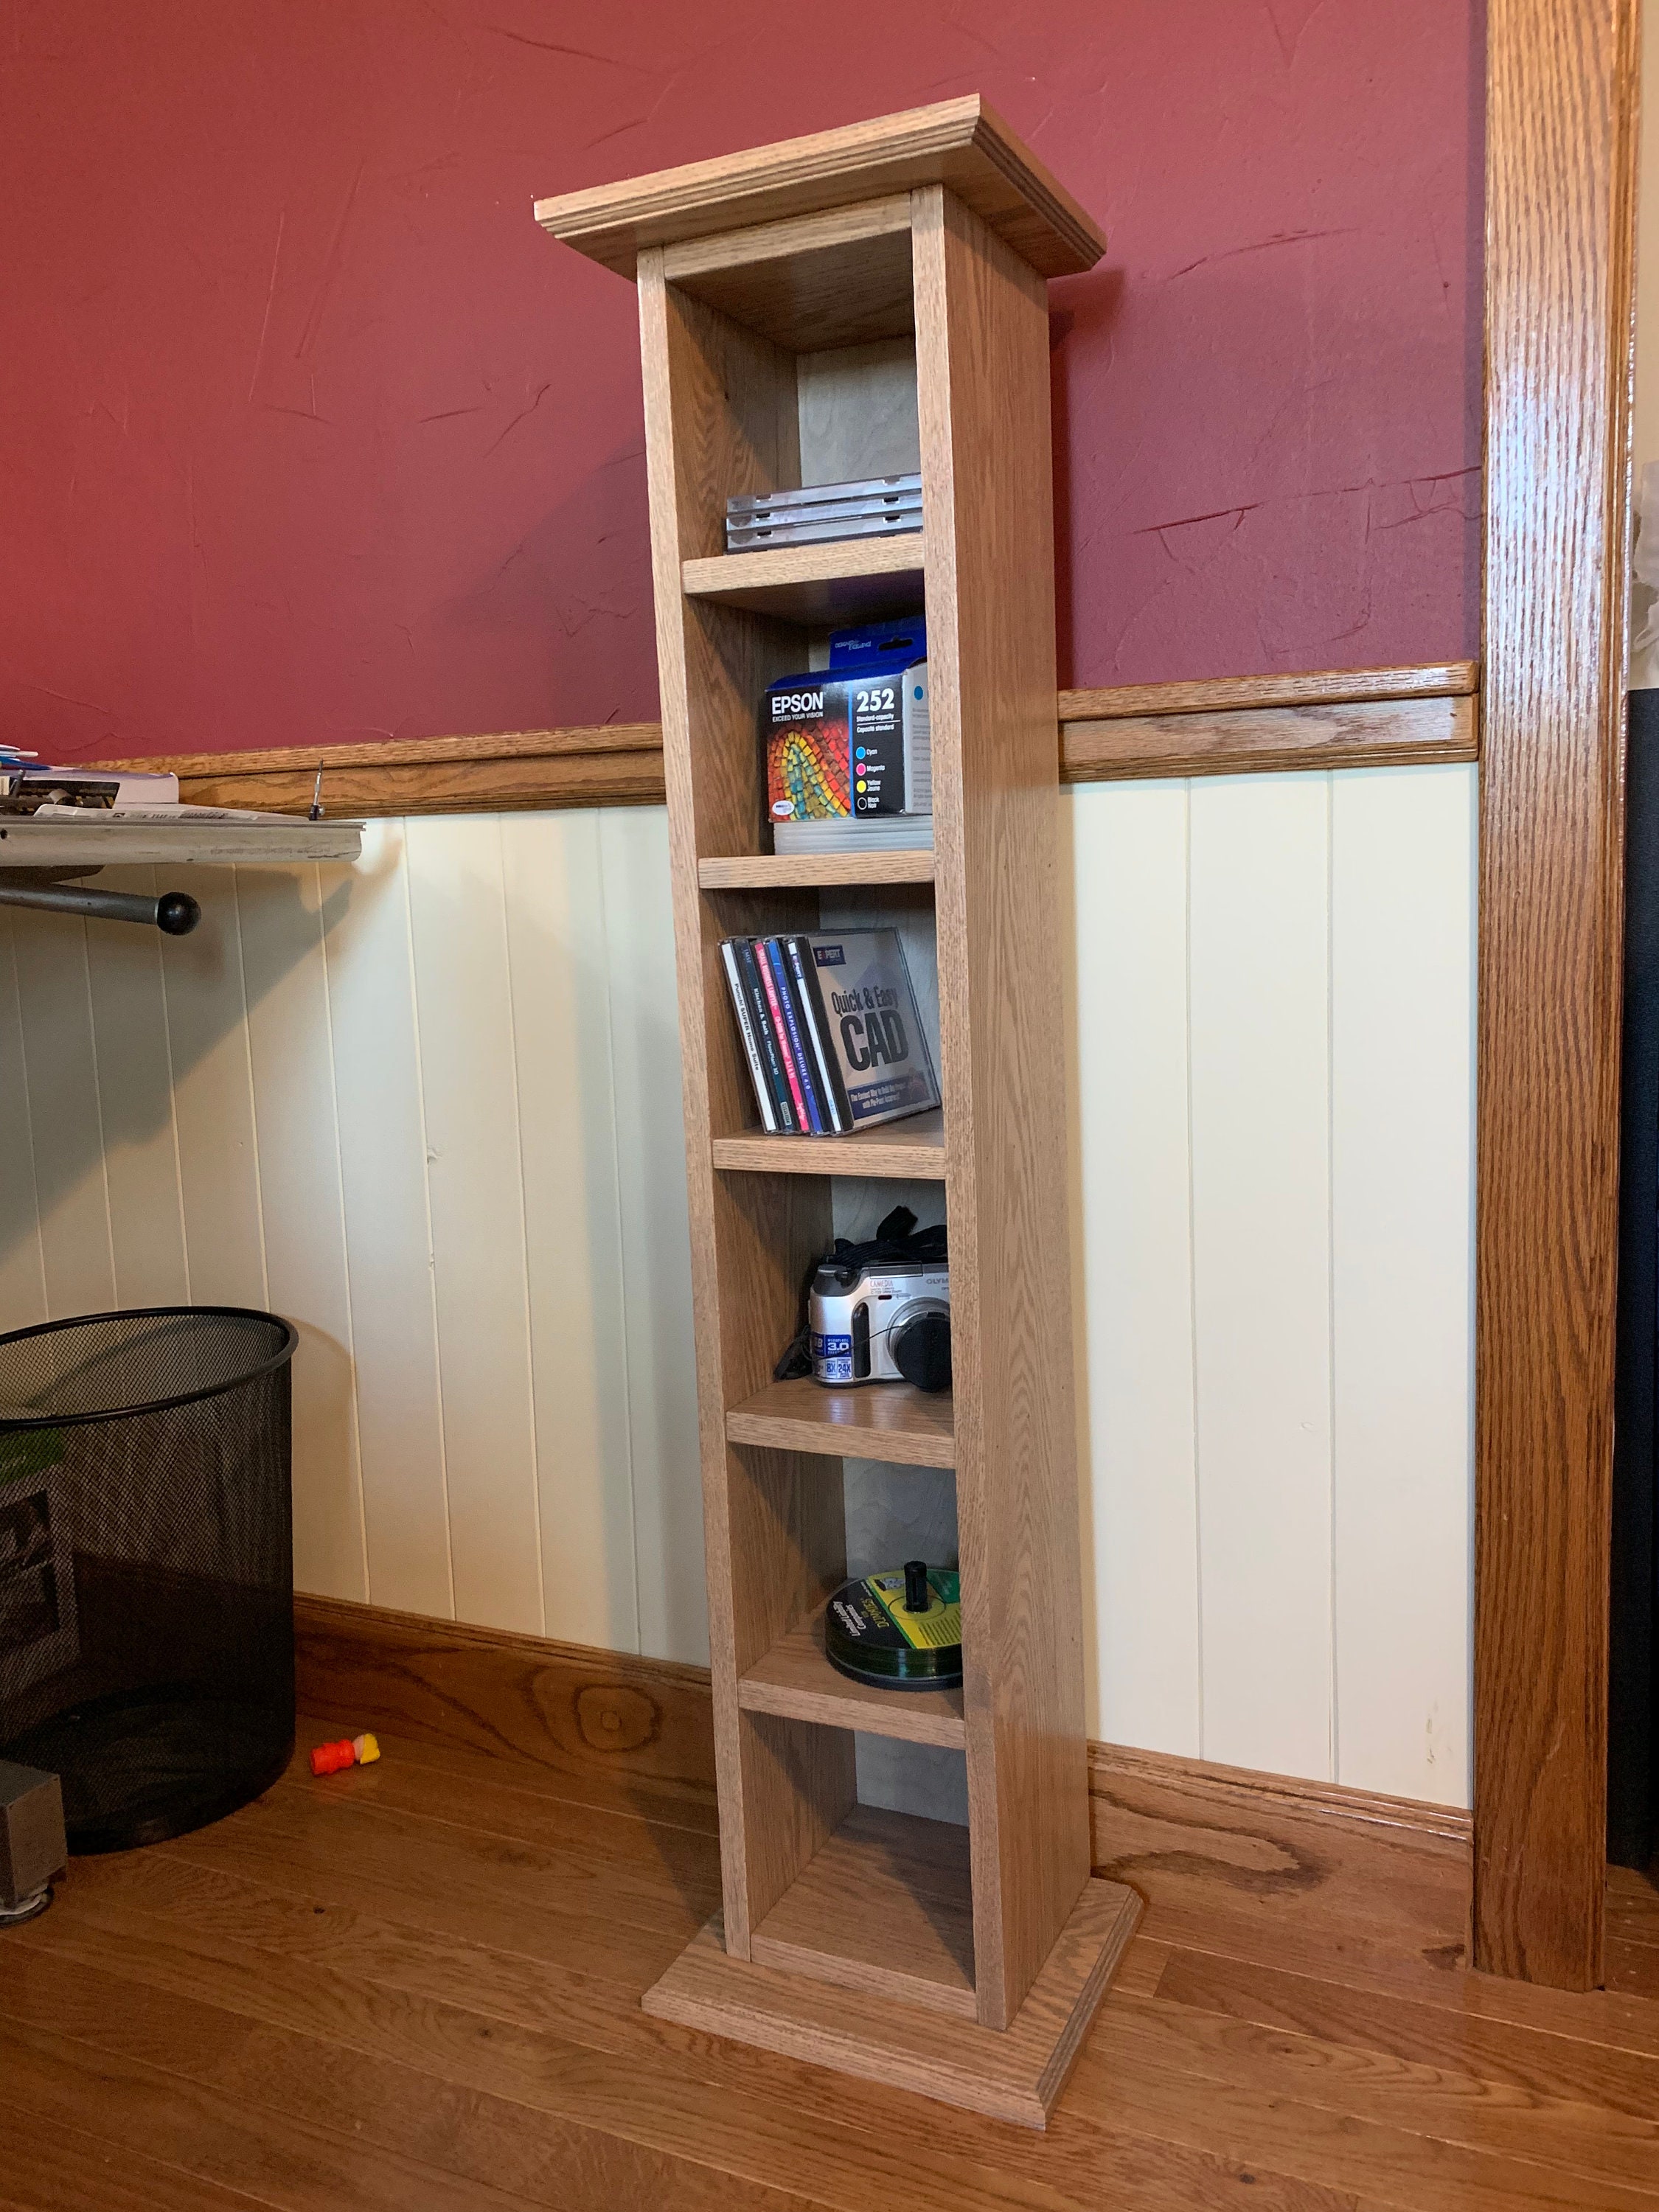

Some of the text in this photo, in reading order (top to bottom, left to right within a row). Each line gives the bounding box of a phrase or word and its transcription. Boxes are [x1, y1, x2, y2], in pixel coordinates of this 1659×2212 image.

[772, 692, 824, 714] EPSON
[857, 688, 894, 712] 252
[753, 987, 763, 1012] Kitchen
[761, 1019, 769, 1035] Bath
[831, 986, 899, 1018] Quick & Easy
[734, 982, 759, 1071] Punch! SUPER Home Suite
[780, 986, 811, 1090] PHOTO EXPLOSION DELUXE 4.0
[840, 1009, 909, 1071] CAD
[827, 1342, 849, 1351] 3.0
[827, 1363, 836, 1373] 8X
[838, 1363, 851, 1373] 24X
[861, 1598, 890, 1628] DUMMIES
